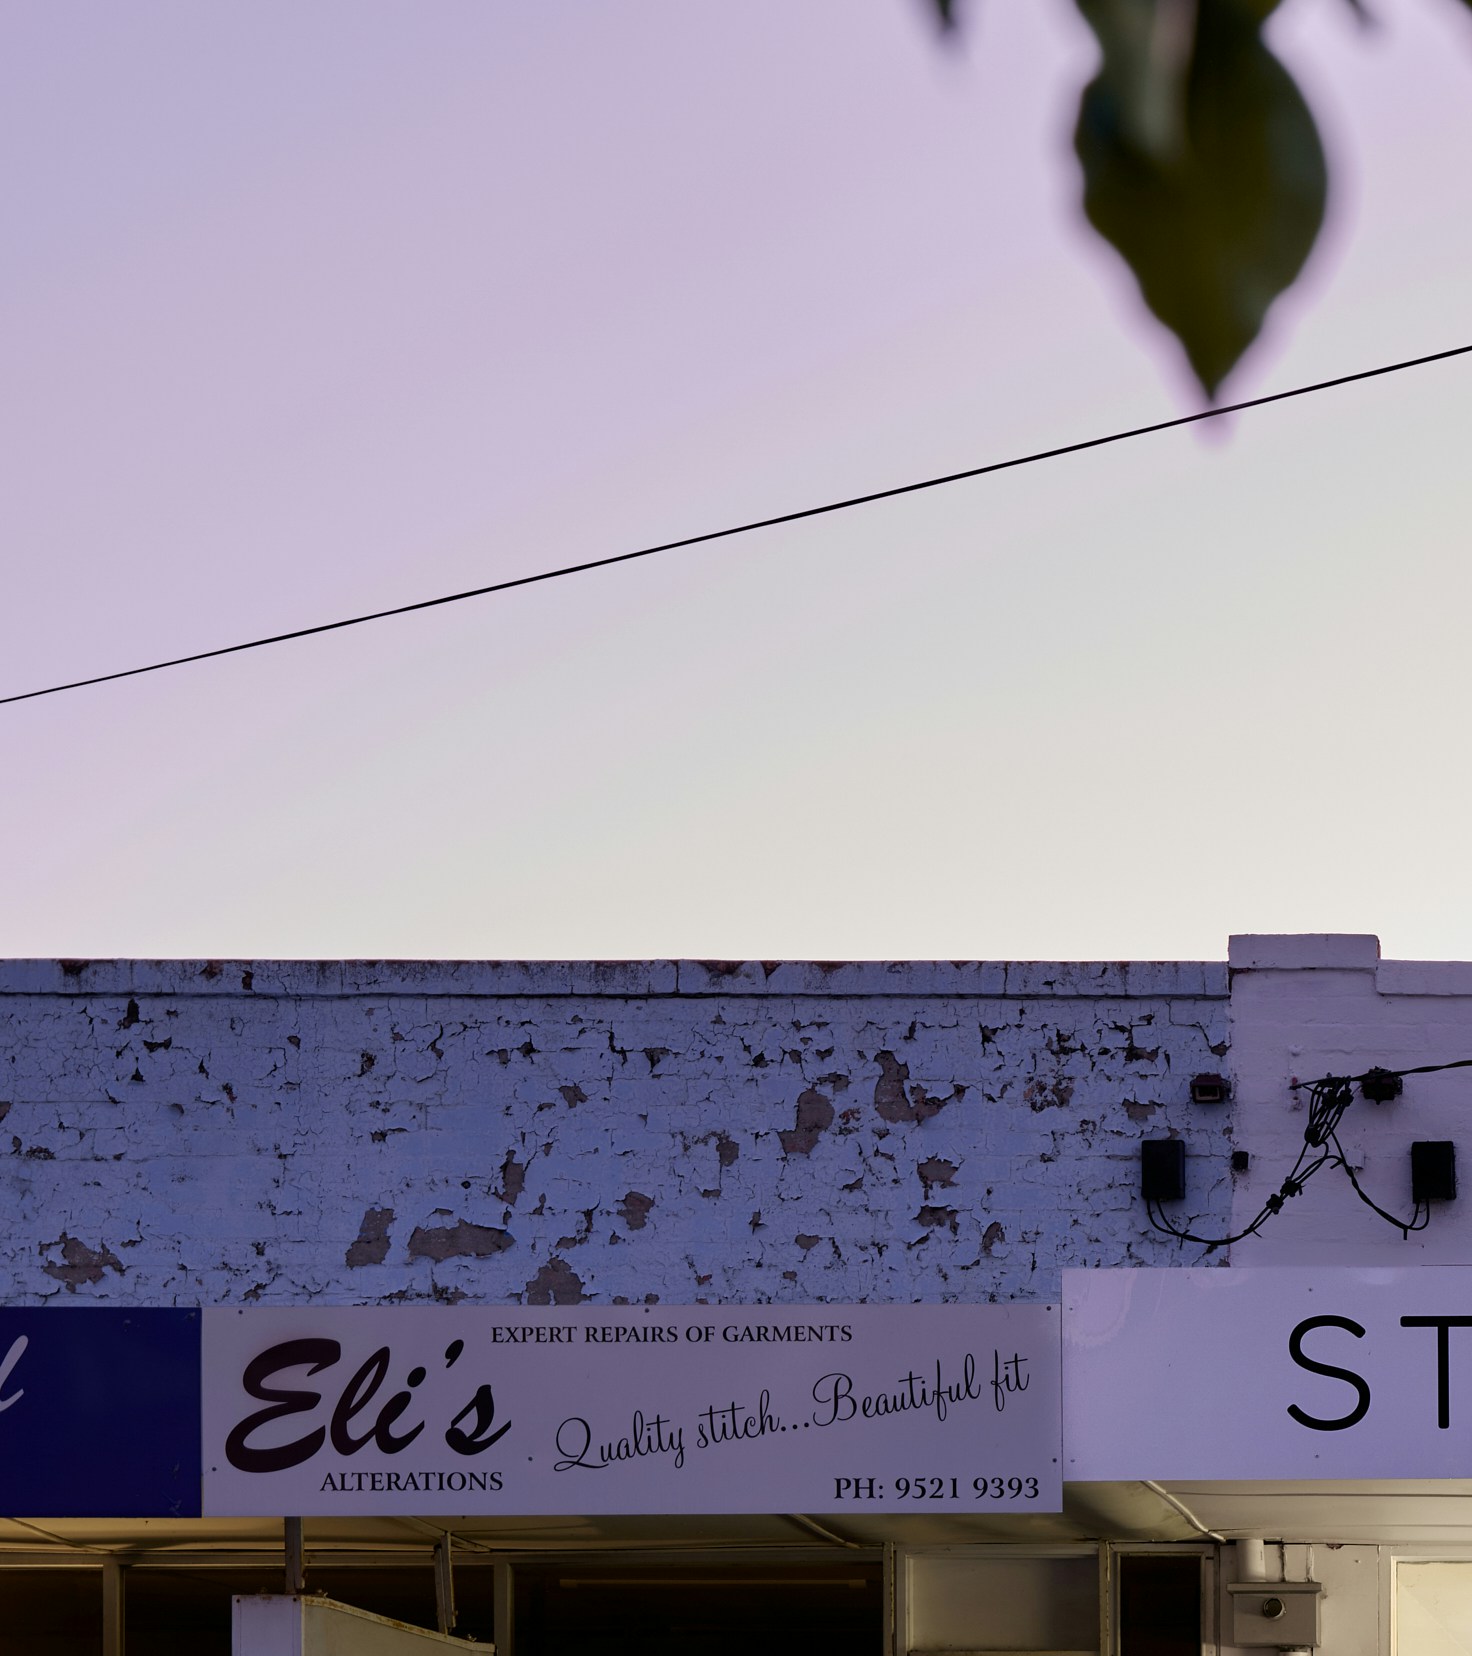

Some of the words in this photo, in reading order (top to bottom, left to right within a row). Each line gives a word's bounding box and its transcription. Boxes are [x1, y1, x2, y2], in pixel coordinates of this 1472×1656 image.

[490, 1326, 577, 1344] EXPERT
[584, 1326, 679, 1343] REPAIRS
[686, 1326, 718, 1343] OF
[722, 1325, 853, 1343] GARMENTS
[225, 1338, 512, 1474] Eli's
[553, 1411, 685, 1473] Quality
[990, 1349, 1030, 1411] fit
[319, 1471, 504, 1492] ALTERATIONS
[833, 1477, 885, 1500] PH:
[894, 1477, 960, 1500] 9521
[972, 1476, 1040, 1500] 9393
